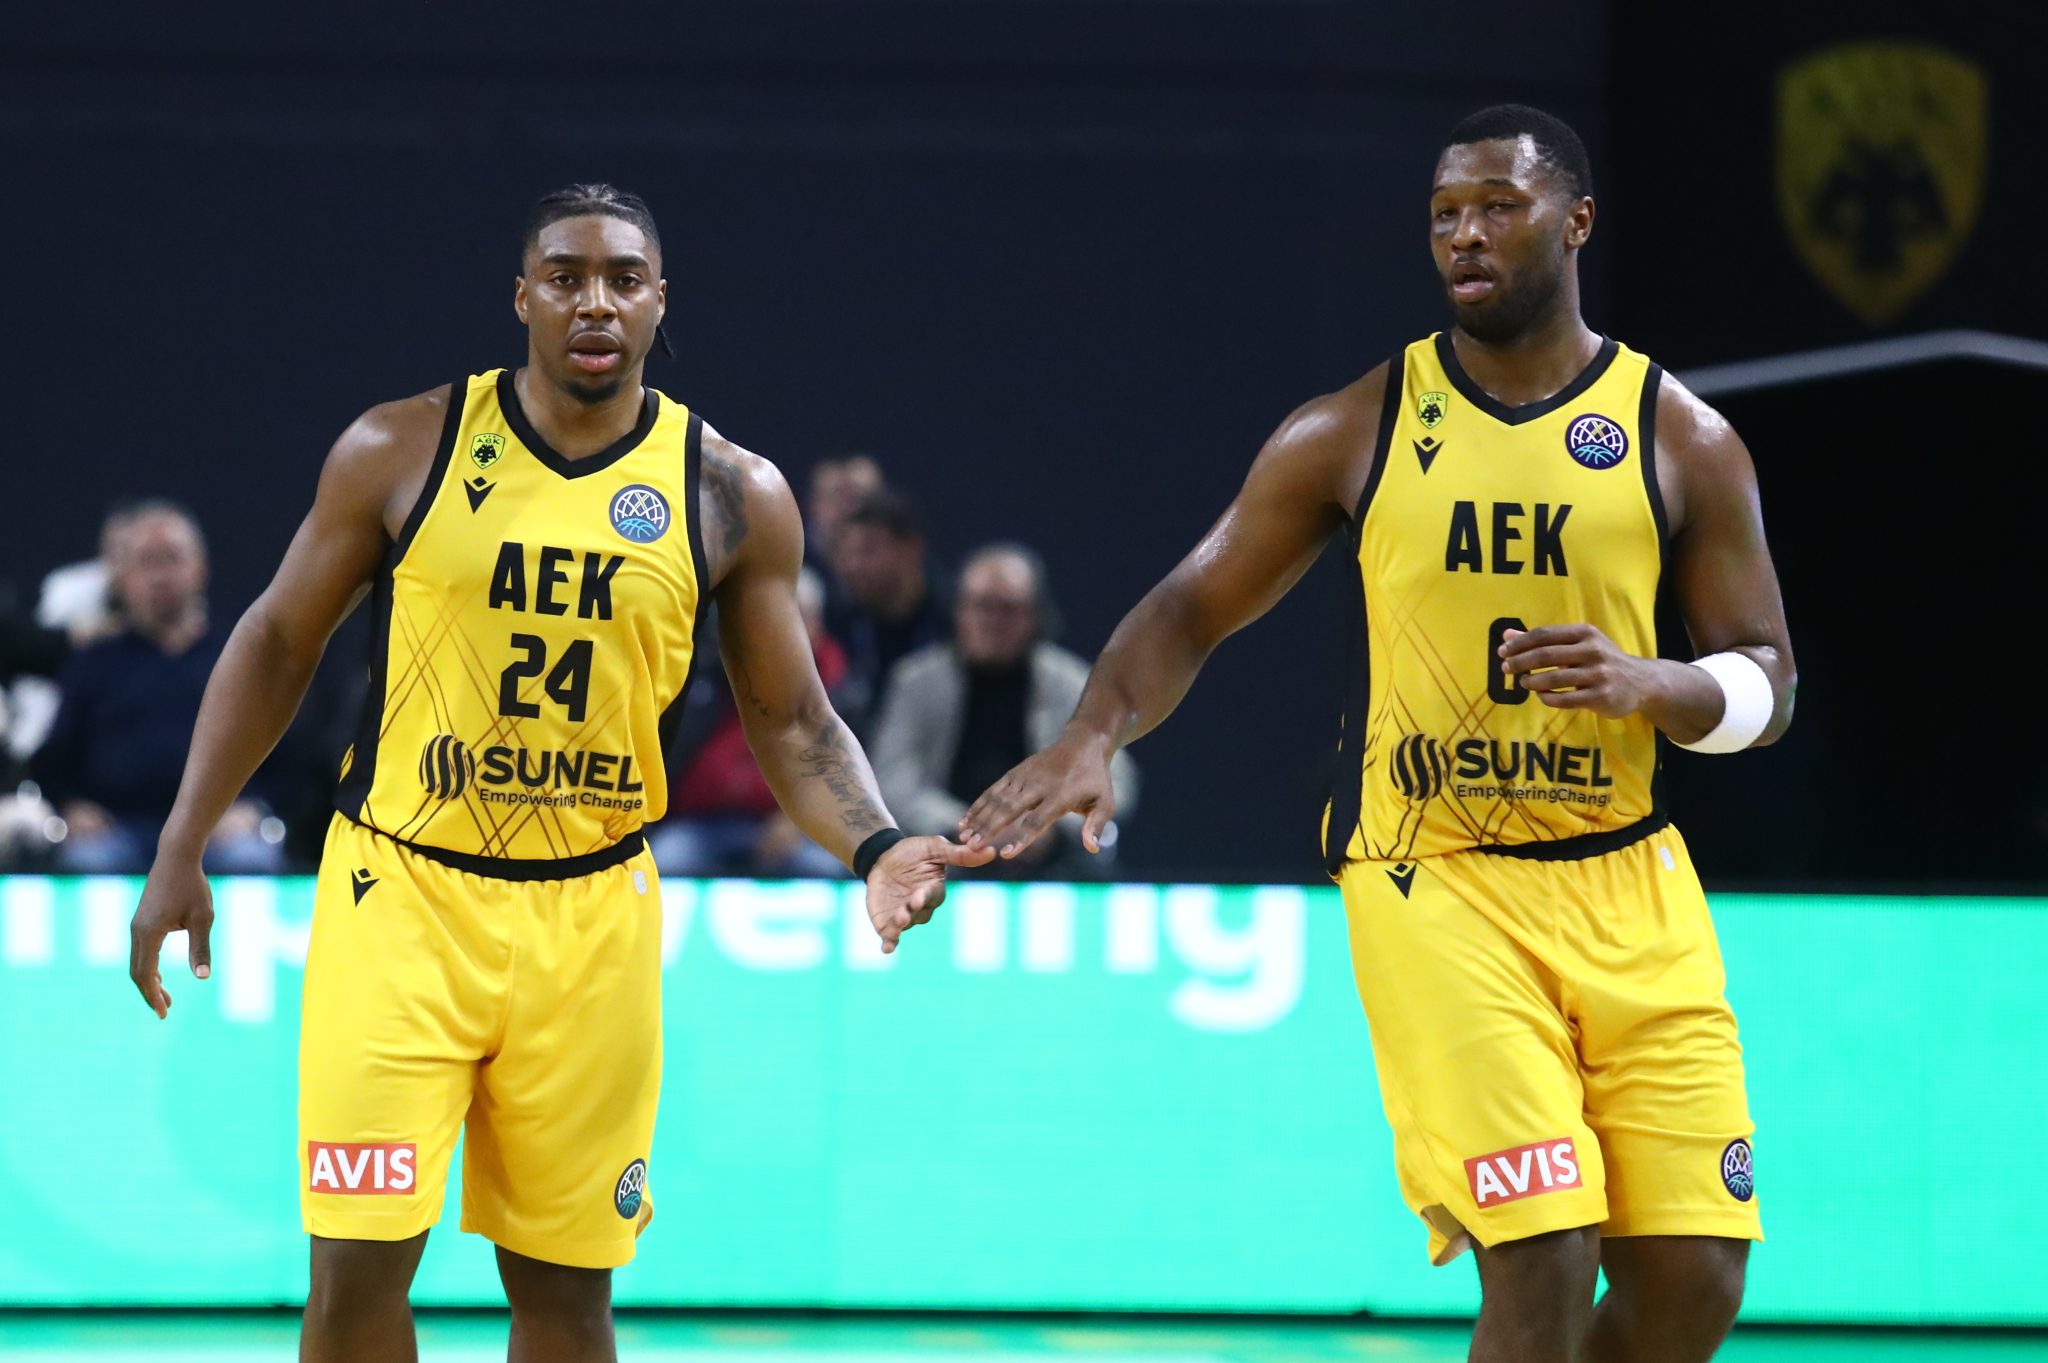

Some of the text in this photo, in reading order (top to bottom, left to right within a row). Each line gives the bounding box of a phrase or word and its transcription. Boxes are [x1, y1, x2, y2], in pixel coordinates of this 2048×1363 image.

[1446, 500, 1573, 577] AEK
[488, 541, 626, 621] AEK
[498, 632, 594, 723] 24
[480, 745, 643, 793] SUNEL
[1455, 738, 1613, 788] SUNEL
[479, 788, 643, 813] Empowering Change
[1456, 784, 1612, 808] Empowering Chang
[311, 1147, 414, 1190] AVIS
[1475, 1142, 1578, 1204] AVIS
